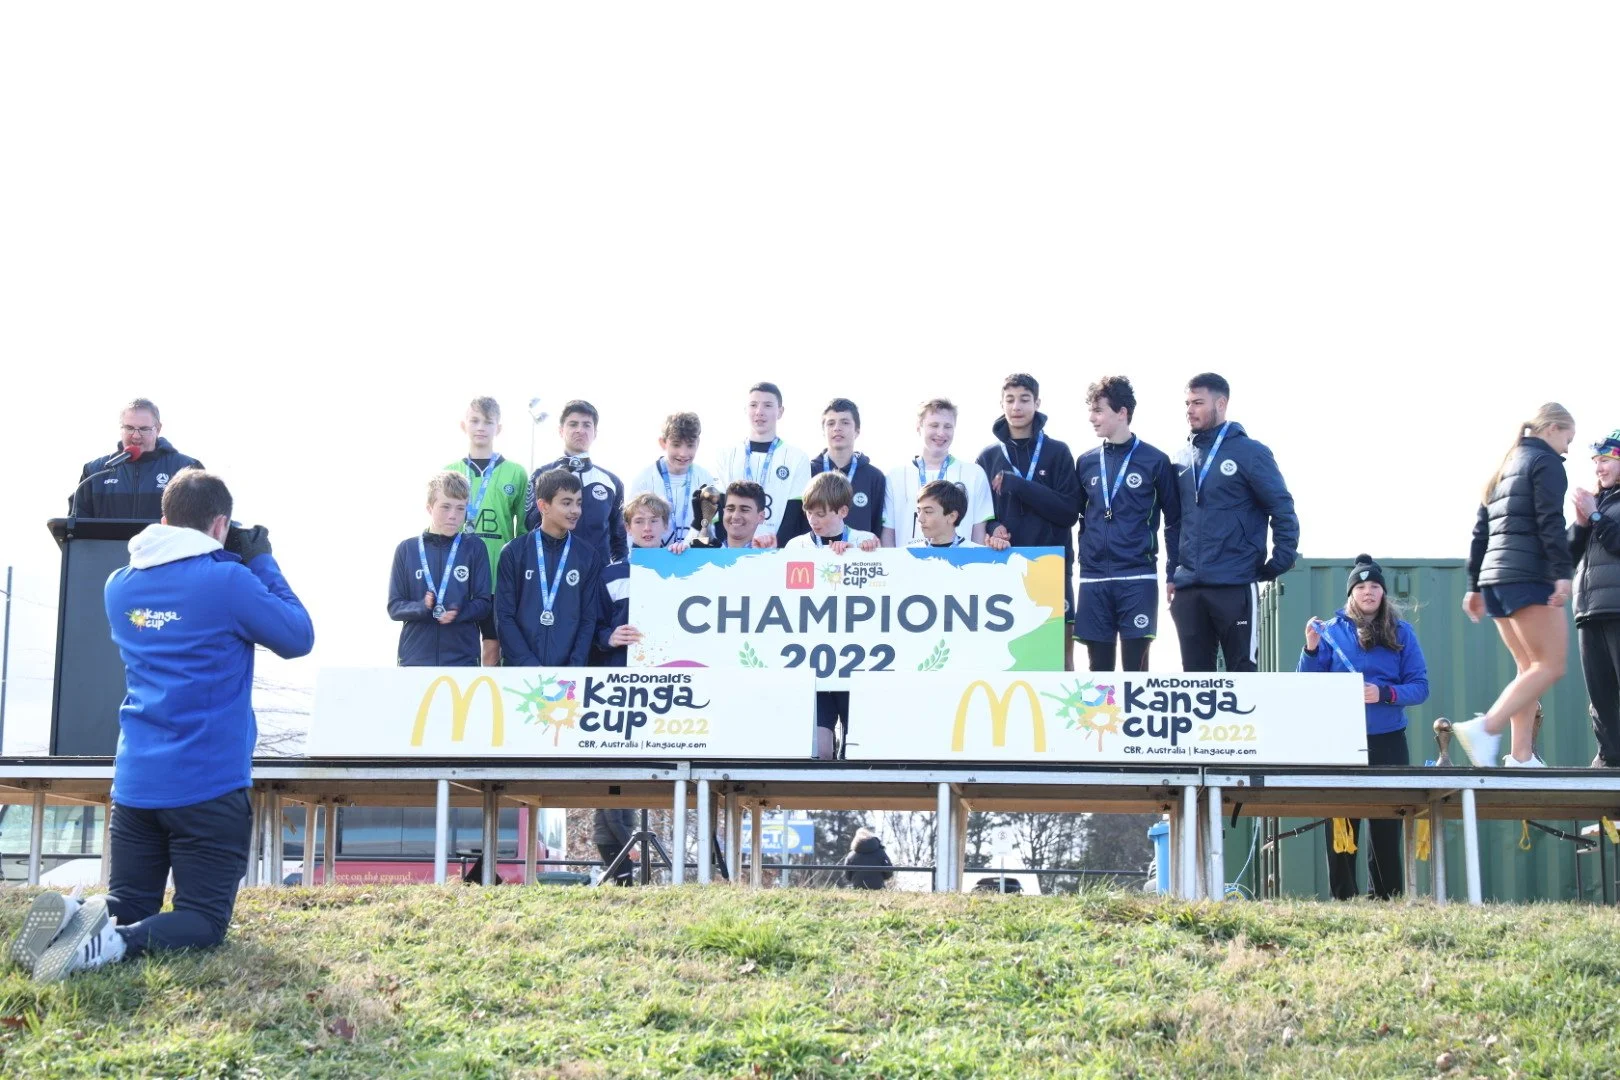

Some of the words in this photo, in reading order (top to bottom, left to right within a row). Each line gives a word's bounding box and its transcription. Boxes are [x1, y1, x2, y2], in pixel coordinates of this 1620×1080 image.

[843, 577, 868, 588] cup
[677, 594, 1015, 634] CHAMPIONS
[145, 620, 164, 630] cup
[780, 643, 896, 678] 2022
[606, 673, 692, 683] McDonald's
[1146, 678, 1235, 688] McDonald's
[579, 710, 648, 740] cup
[654, 718, 709, 735] 2022
[1122, 714, 1193, 746] cup
[1198, 724, 1257, 741] 2022
[578, 741, 597, 749] CBR,
[600, 740, 638, 748] Australia
[1123, 746, 1144, 754] CBR,
[1147, 746, 1186, 754] Australia
